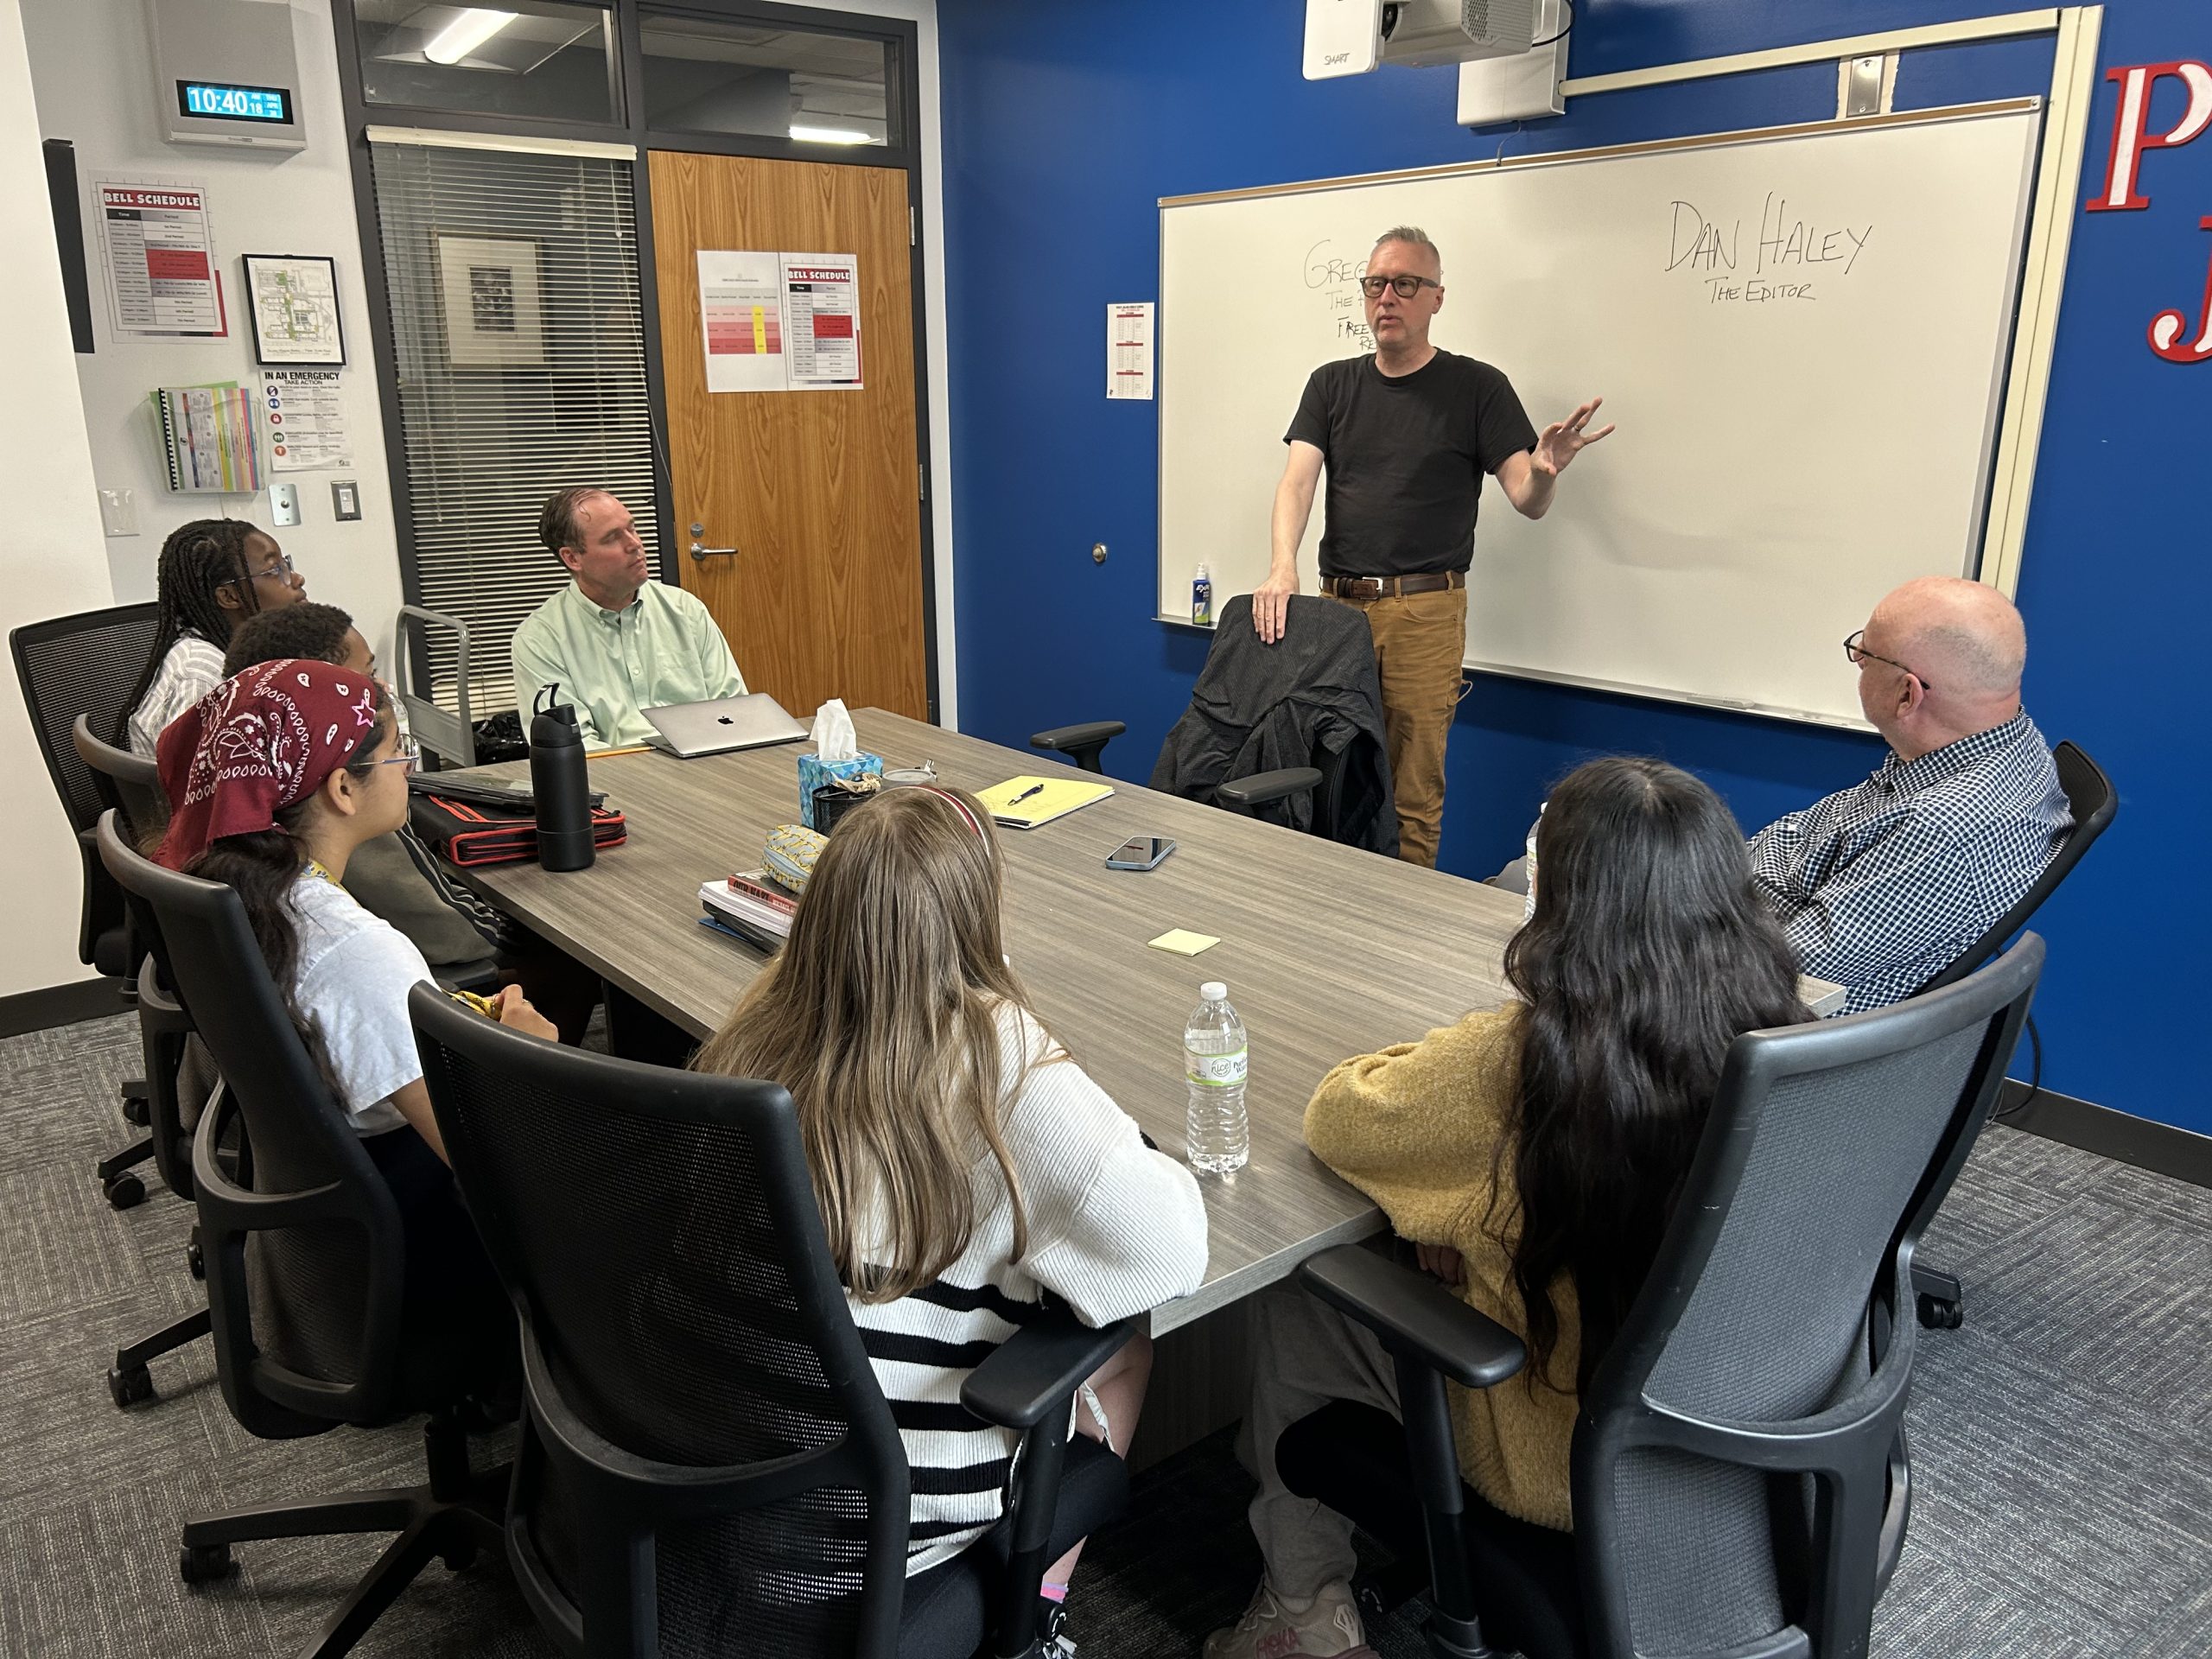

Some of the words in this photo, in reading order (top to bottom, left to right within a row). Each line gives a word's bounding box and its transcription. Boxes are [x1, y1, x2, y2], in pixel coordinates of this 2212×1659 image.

[1324, 52, 1350, 65] SMART
[190, 88, 248, 114] 10:40
[249, 102, 264, 115] 18
[104, 192, 134, 203] BELL
[137, 194, 200, 207] SCHEDULE
[1664, 200, 1739, 272] DAN
[1756, 190, 1872, 275] HALEY
[788, 270, 808, 279] BELL
[810, 270, 849, 280] SCHEDULE
[1705, 276, 1741, 303] THE
[1745, 279, 1816, 302] EDITOR
[1325, 289, 1353, 310] THE
[264, 372, 274, 380] IN
[276, 372, 287, 380] AN
[289, 372, 340, 380] EMERGENCY
[1211, 1063, 1229, 1073] nice
